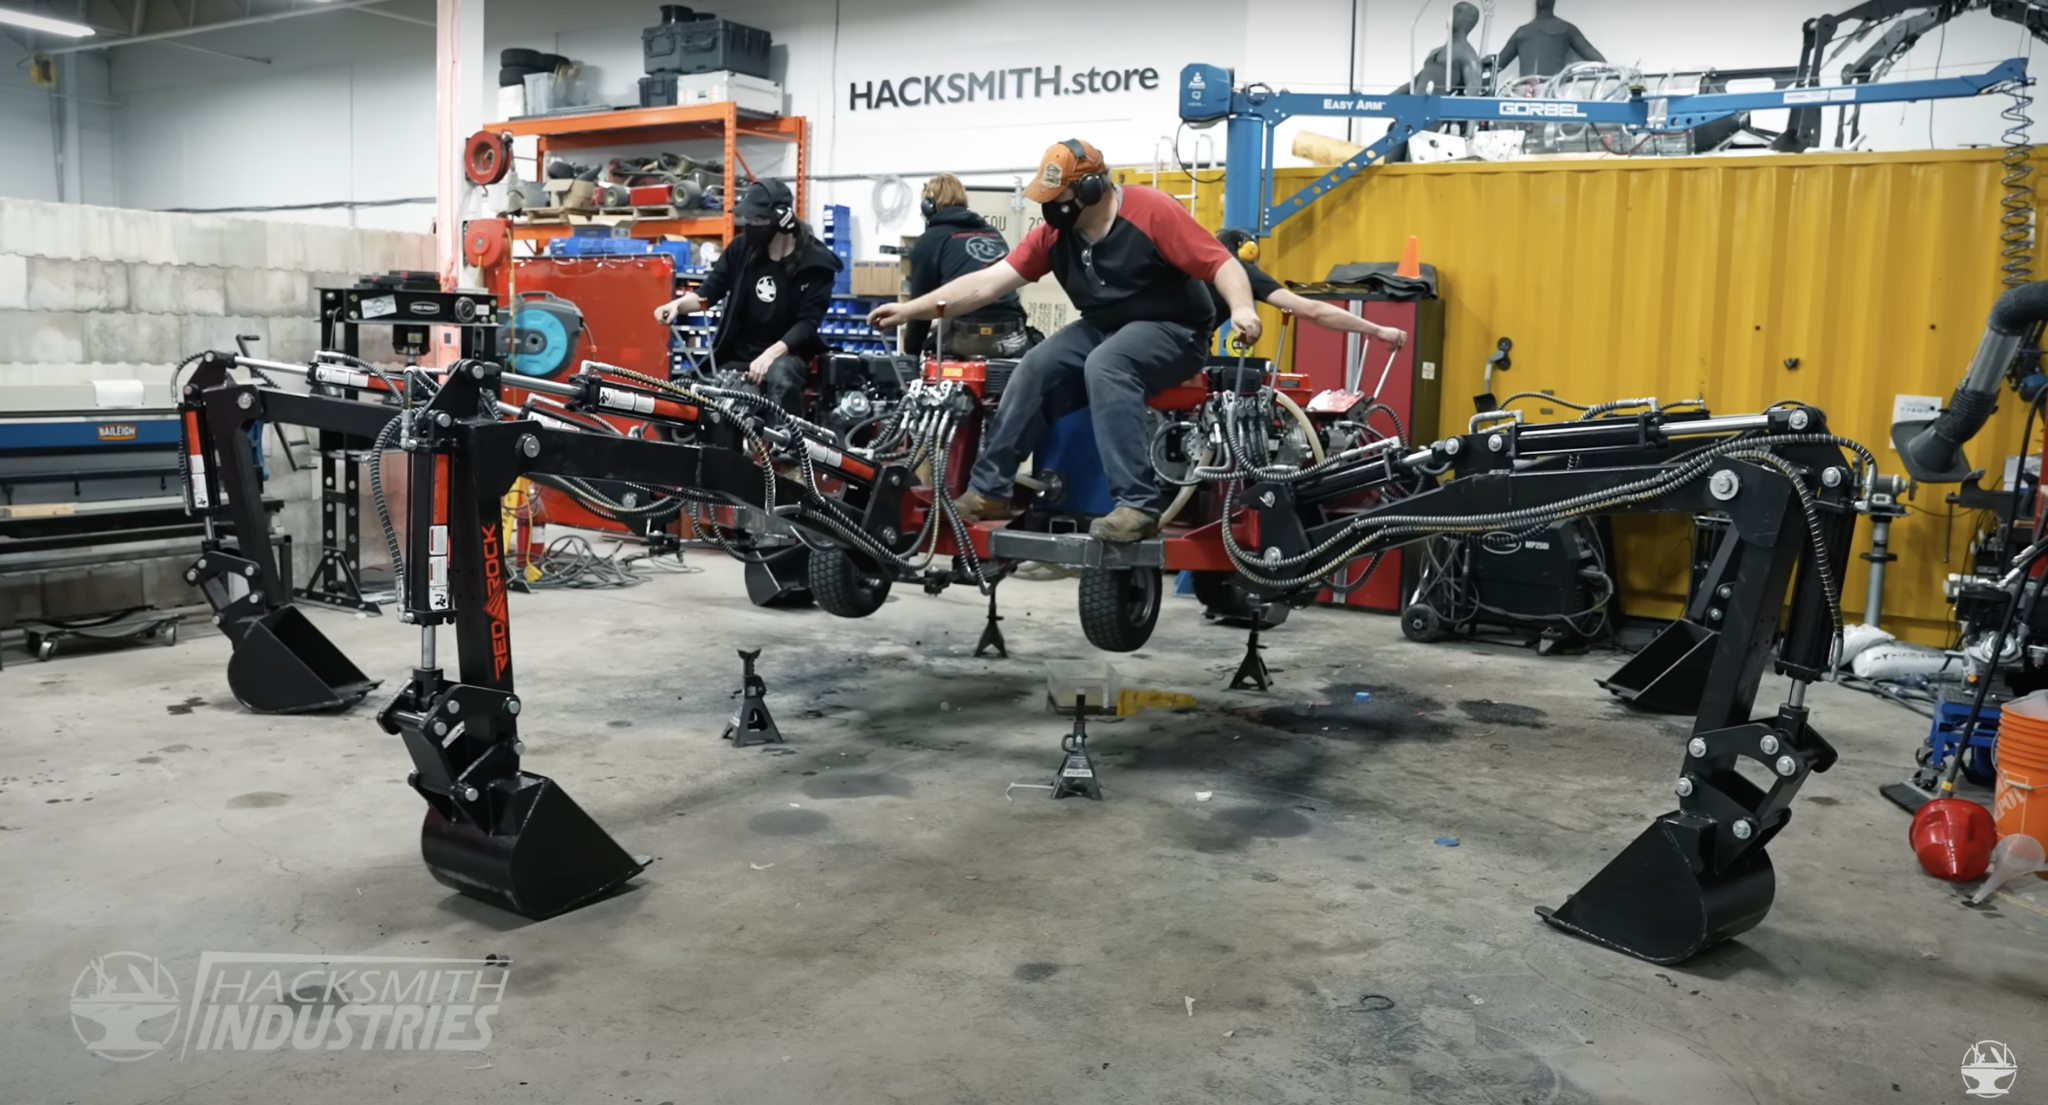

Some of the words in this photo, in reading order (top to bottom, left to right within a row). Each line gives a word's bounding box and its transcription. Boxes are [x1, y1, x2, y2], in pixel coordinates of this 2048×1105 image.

[849, 65, 1159, 110] HACKSMITH.store
[1323, 98, 1352, 110] EASY
[1499, 102, 1588, 117] GORBEL
[99, 425, 136, 437] BAILEIGH
[481, 522, 502, 596] ROCK
[491, 621, 509, 681] RED
